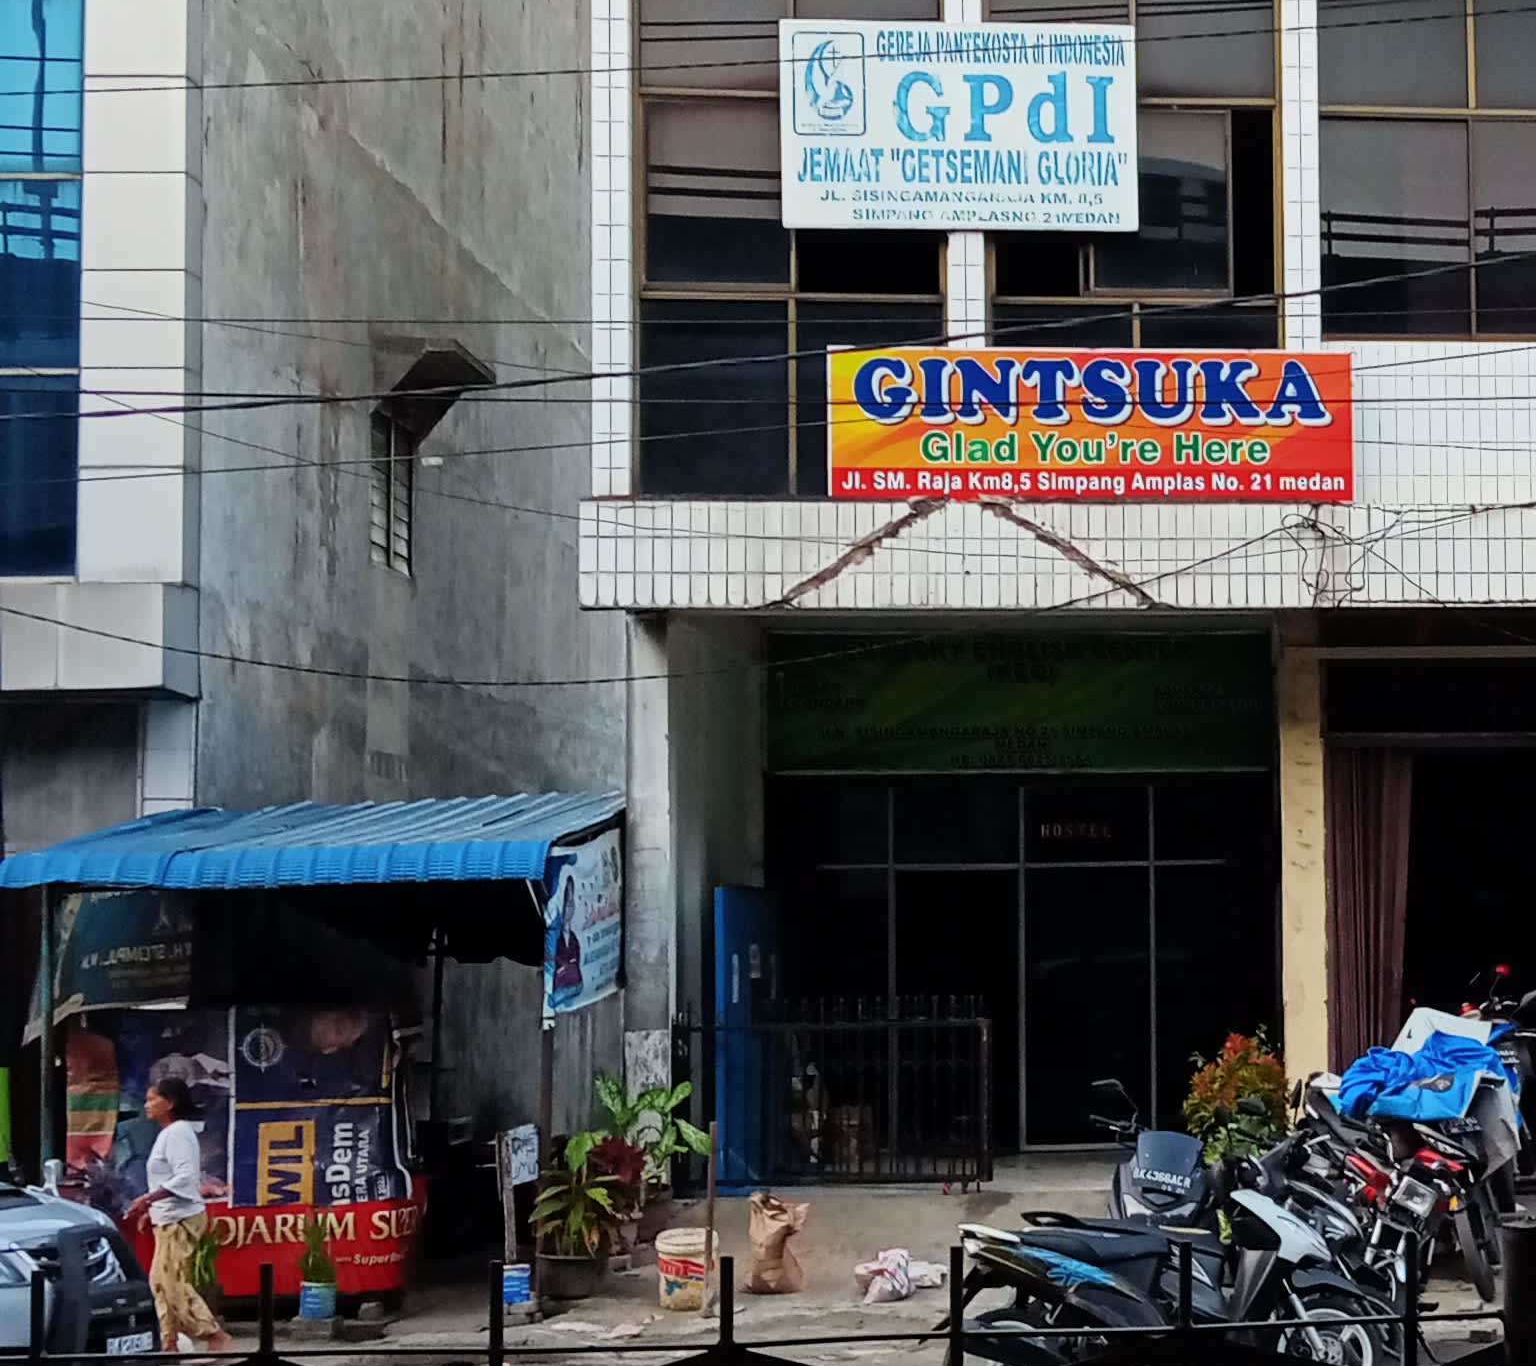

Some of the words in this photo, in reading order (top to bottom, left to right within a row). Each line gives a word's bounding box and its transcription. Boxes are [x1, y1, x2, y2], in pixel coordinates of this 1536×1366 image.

[876, 30, 933, 62] GEREJA
[936, 32, 1030, 65] PANTEKOSTA
[1048, 34, 1126, 68] INDONESIA
[893, 71, 1115, 144] GPdI
[797, 147, 885, 184] JEMAAT
[854, 357, 1332, 426] GINTSUKA
[921, 431, 1018, 464] Glad
[1031, 432, 1160, 464] You're
[1174, 433, 1270, 464] Here
[873, 471, 911, 490] SM.
[917, 471, 962, 494] Raja
[968, 472, 1031, 493] Km8,5
[1037, 472, 1125, 495] Simpang
[1131, 473, 1205, 495] Amplas
[1212, 473, 1245, 490] No.
[1251, 473, 1272, 490] 21
[1280, 473, 1345, 491] medan
